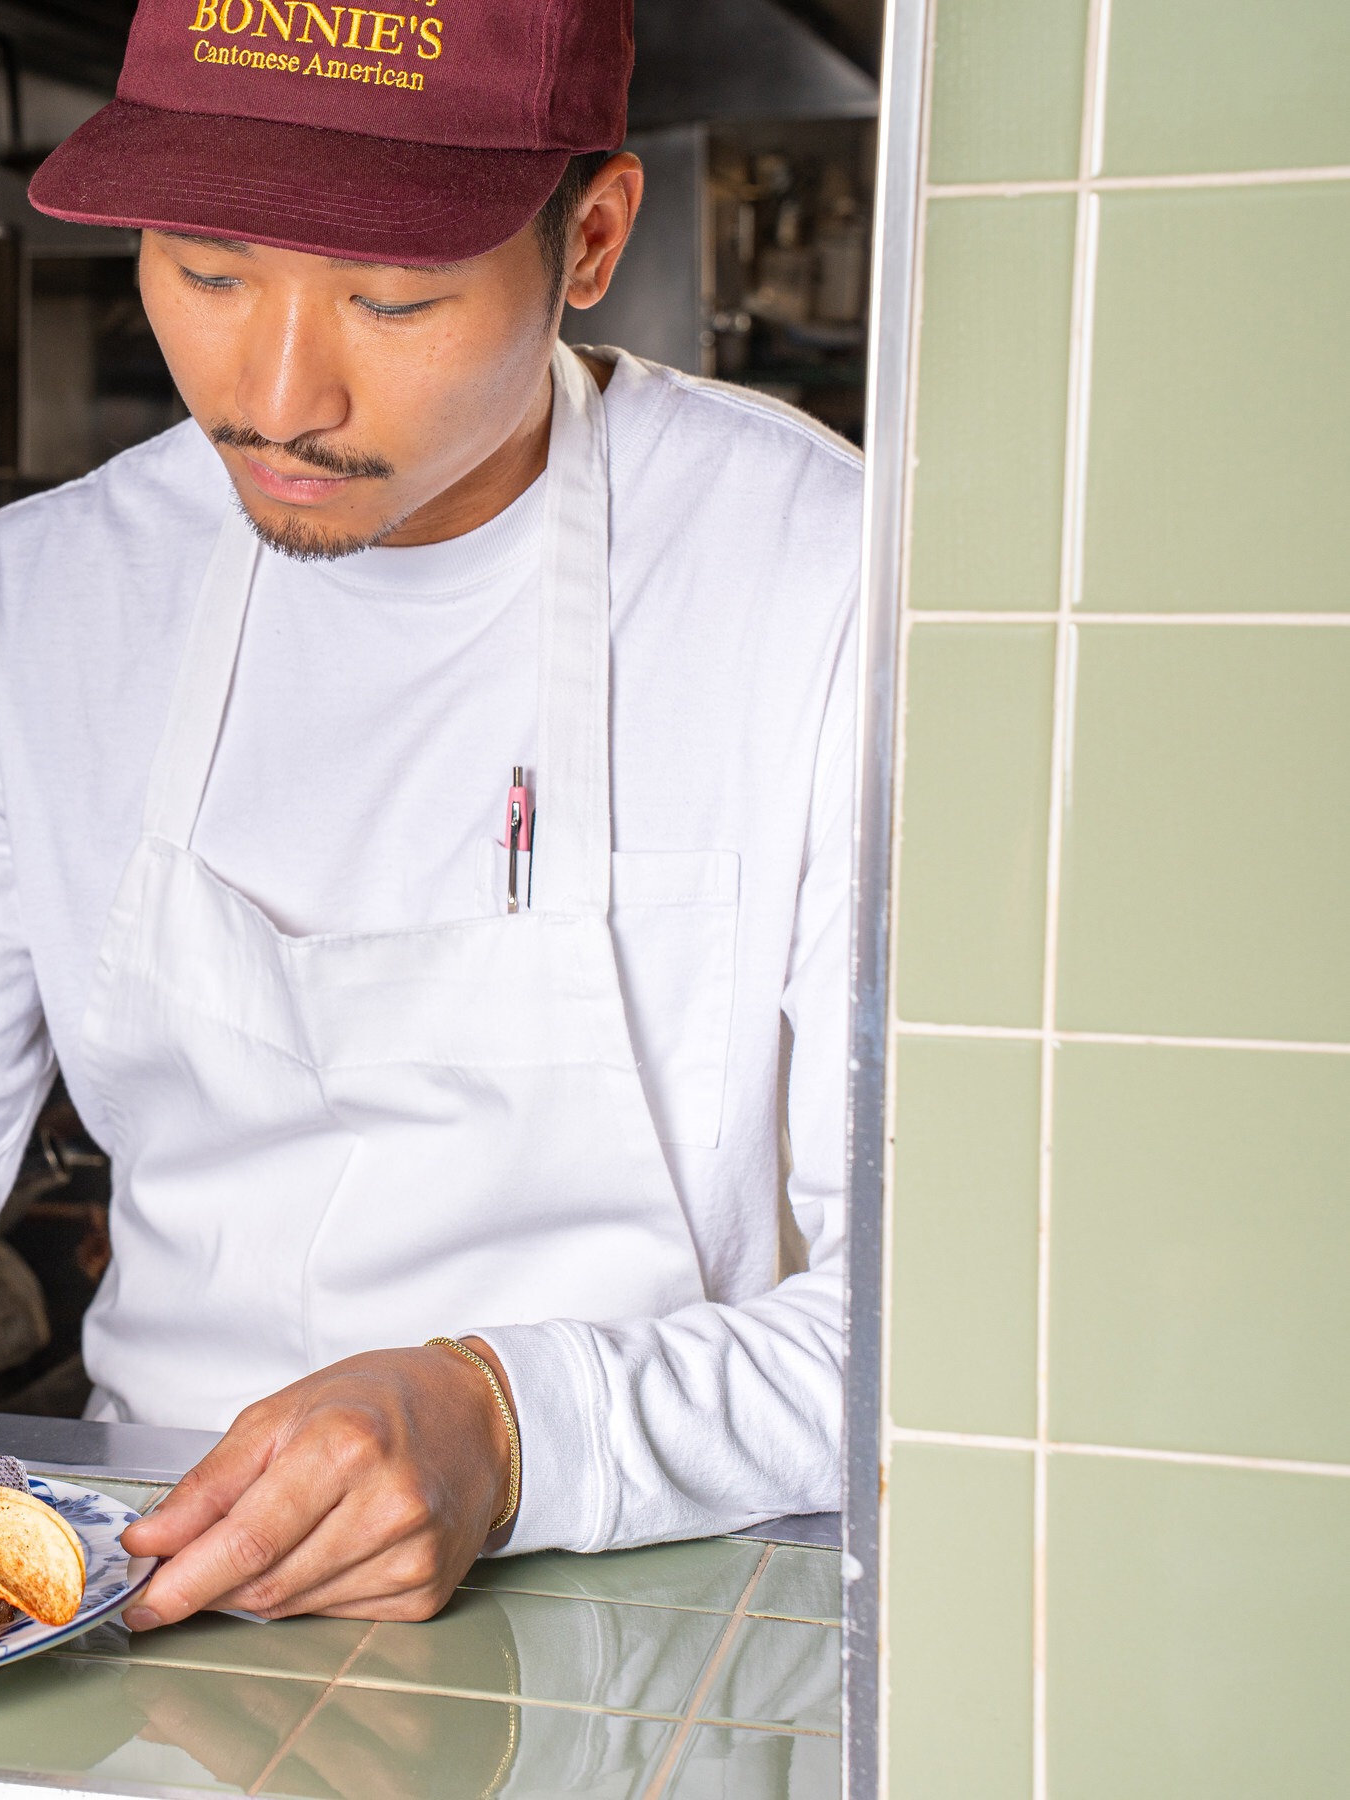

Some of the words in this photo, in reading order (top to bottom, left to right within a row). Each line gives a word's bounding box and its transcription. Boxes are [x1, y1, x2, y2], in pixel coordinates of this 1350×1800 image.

[188, 0, 443, 60] BONNIE'S
[193, 39, 301, 72] Cantonese
[302, 53, 425, 91] American
